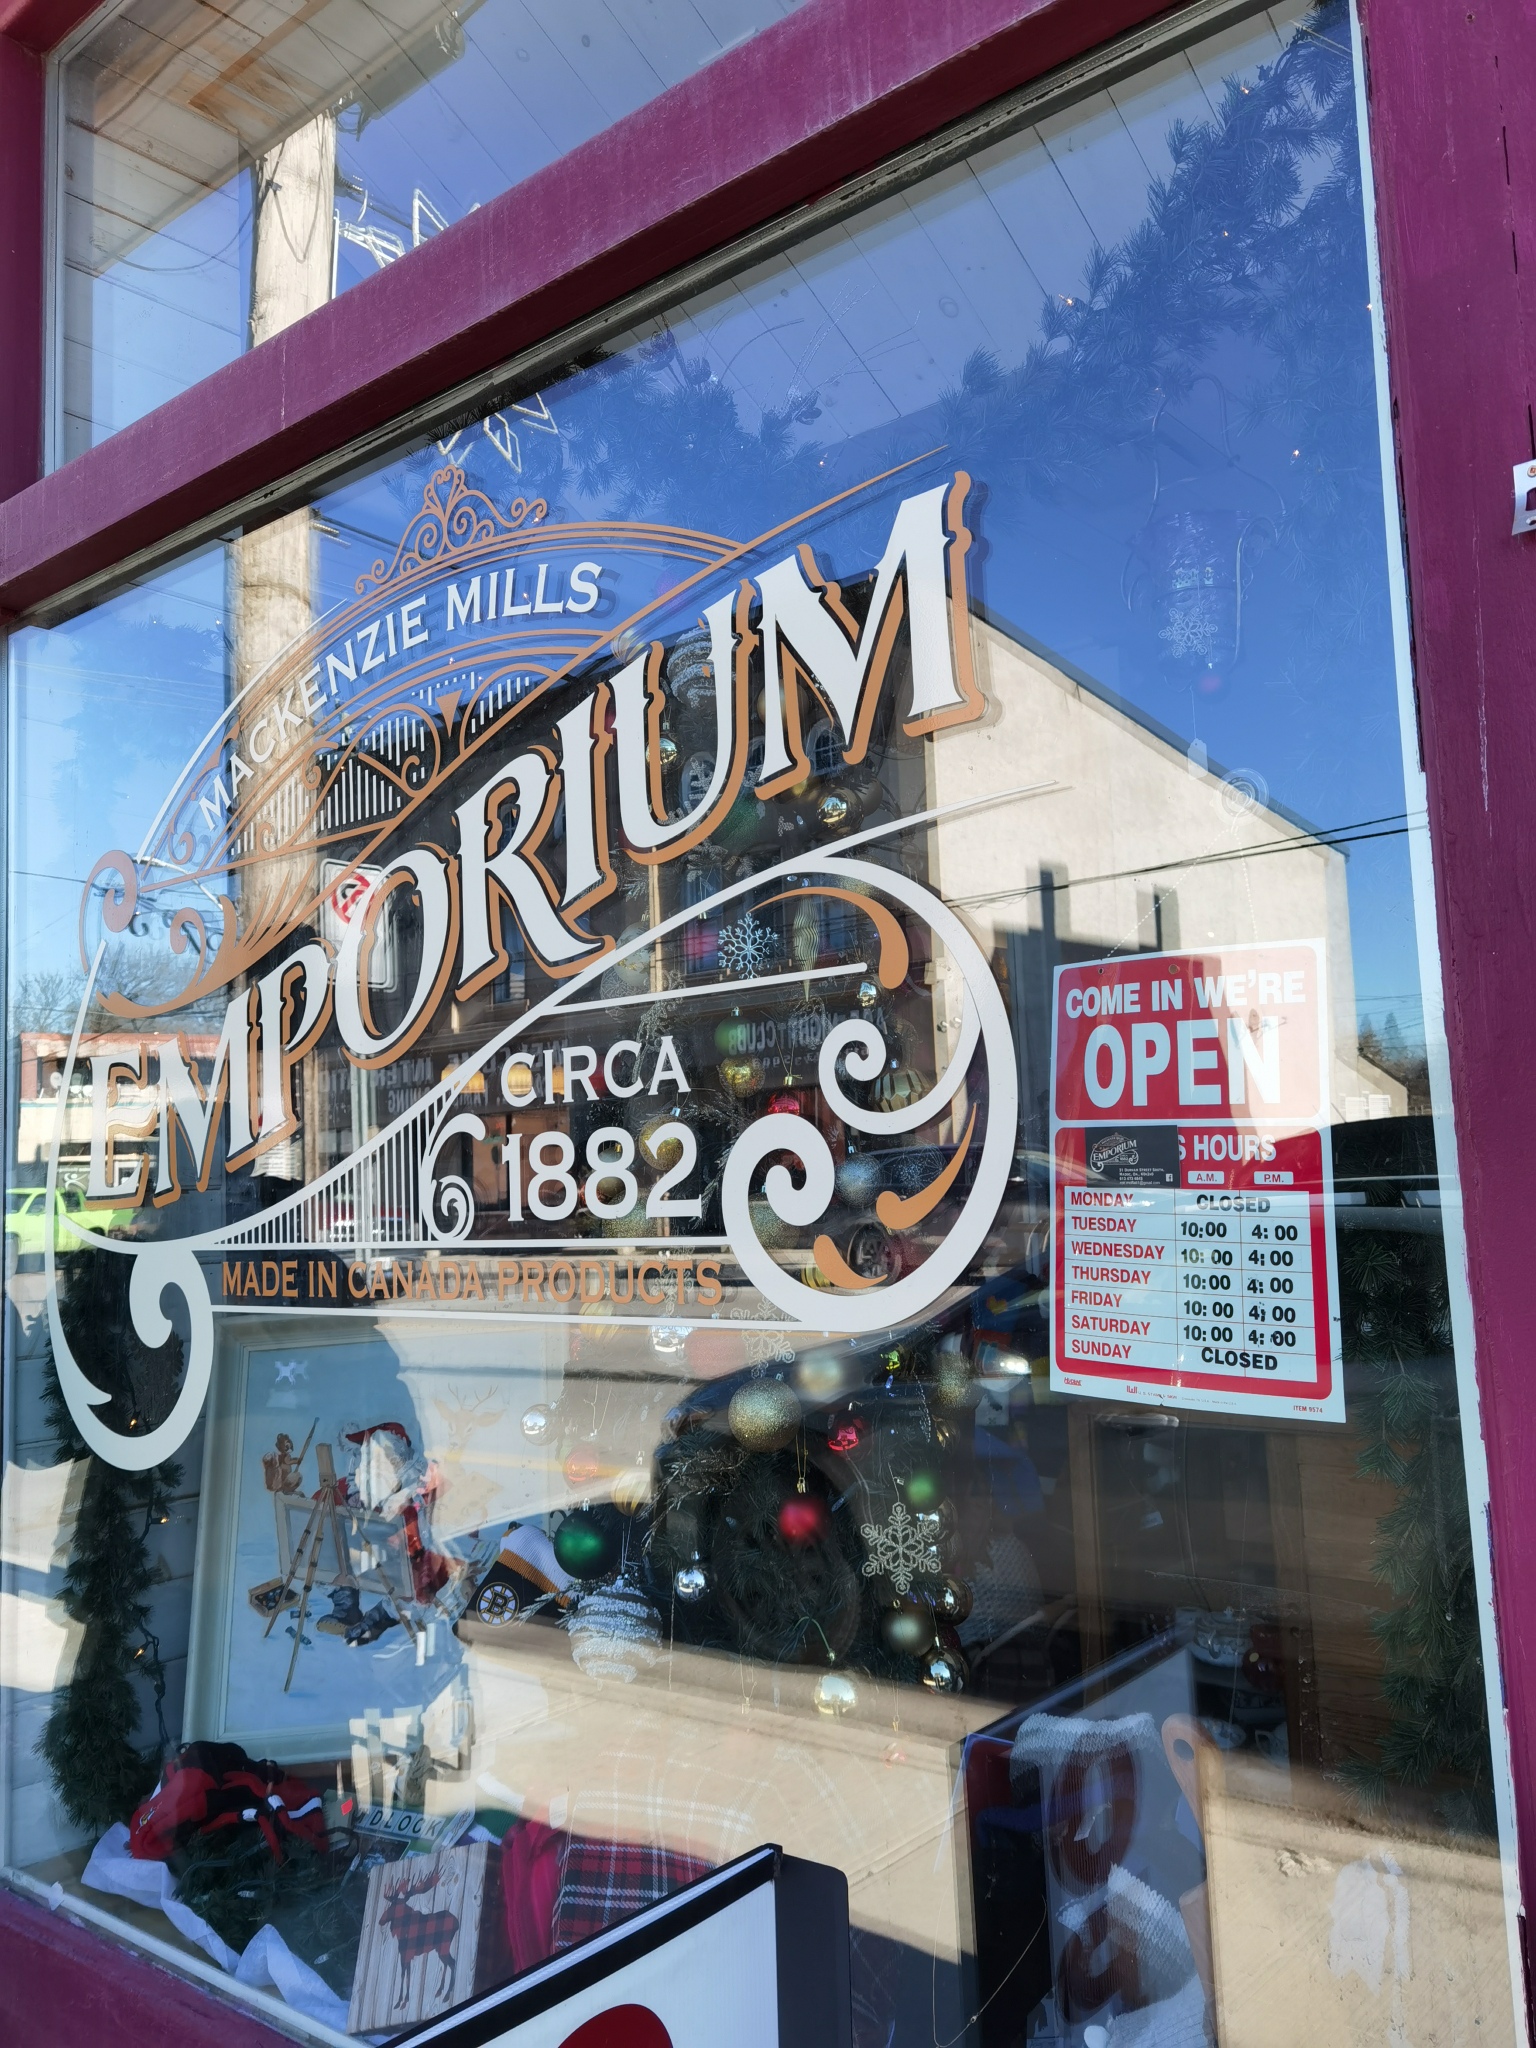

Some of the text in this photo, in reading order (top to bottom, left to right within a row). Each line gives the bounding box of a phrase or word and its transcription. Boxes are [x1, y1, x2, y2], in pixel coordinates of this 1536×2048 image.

[199, 561, 603, 831] MACKENZIE MILLS
[84, 471, 985, 1209] EMPORIUM
[1066, 969, 1306, 1019] COME IN WE'RE
[500, 1035, 692, 1108] CIRCA
[1084, 1016, 1281, 1108] OPEN
[1093, 1139, 1137, 1161] EMPORIUM
[1193, 1134, 1277, 1161] HOURS
[502, 1122, 702, 1222] 1882
[1195, 1172, 1284, 1183] A.M. P.M.
[1071, 1192, 1270, 1213] MONDAY CLOSED
[1072, 1216, 1137, 1233] TUESDAY
[1180, 1221, 1227, 1238] 10:00
[1071, 1241, 1165, 1260] WEDNESDAY
[221, 1259, 724, 1305] MADE IN CANADA PRODUCTS
[1072, 1265, 1151, 1284] THURSDAY
[1183, 1273, 1231, 1290] 10:00
[1071, 1290, 1122, 1308] FRIDAY
[1071, 1315, 1151, 1336] SATURDAY
[1071, 1339, 1278, 1370] SUNDAY CLOSED
